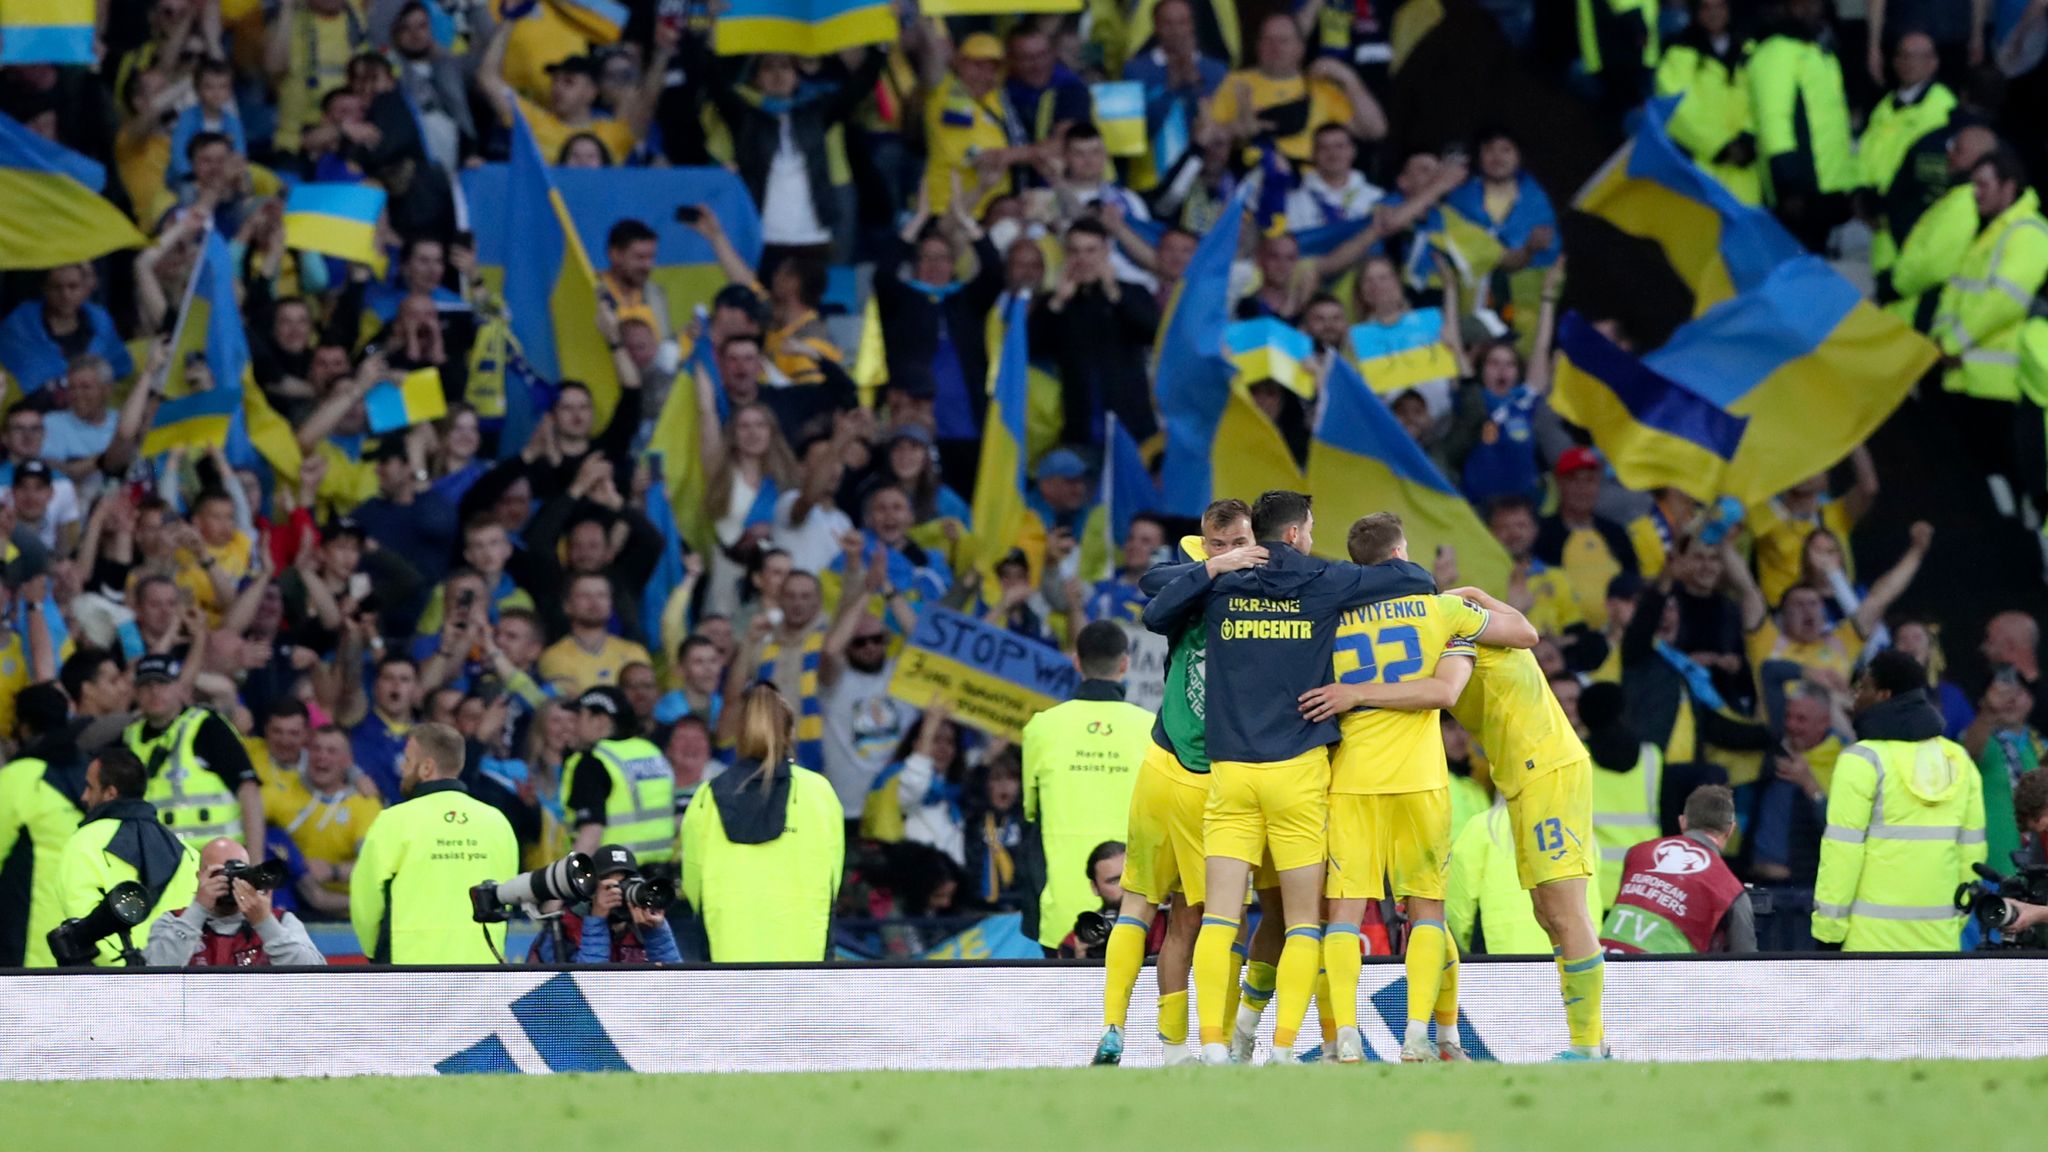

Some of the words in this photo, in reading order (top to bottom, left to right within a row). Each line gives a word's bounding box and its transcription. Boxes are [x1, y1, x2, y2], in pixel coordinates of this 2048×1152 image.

[1228, 598, 1300, 613] UKRAINE
[1338, 600, 1427, 626] ATVIYENKO
[1234, 619, 1313, 639] EPICENTR
[916, 611, 1027, 674] STOP
[1033, 650, 1079, 692] WA
[1333, 624, 1424, 686] 22
[1075, 749, 1104, 759] Here
[1107, 750, 1120, 759] to
[1068, 764, 1105, 772] assist
[1107, 765, 1129, 774] you
[435, 838, 464, 847] Here
[465, 838, 478, 847] to
[1533, 817, 1564, 852] 13
[430, 851, 465, 860] assist
[467, 852, 489, 862] you
[1630, 872, 1688, 903] EUROPEAN
[1611, 908, 1660, 943] TV
